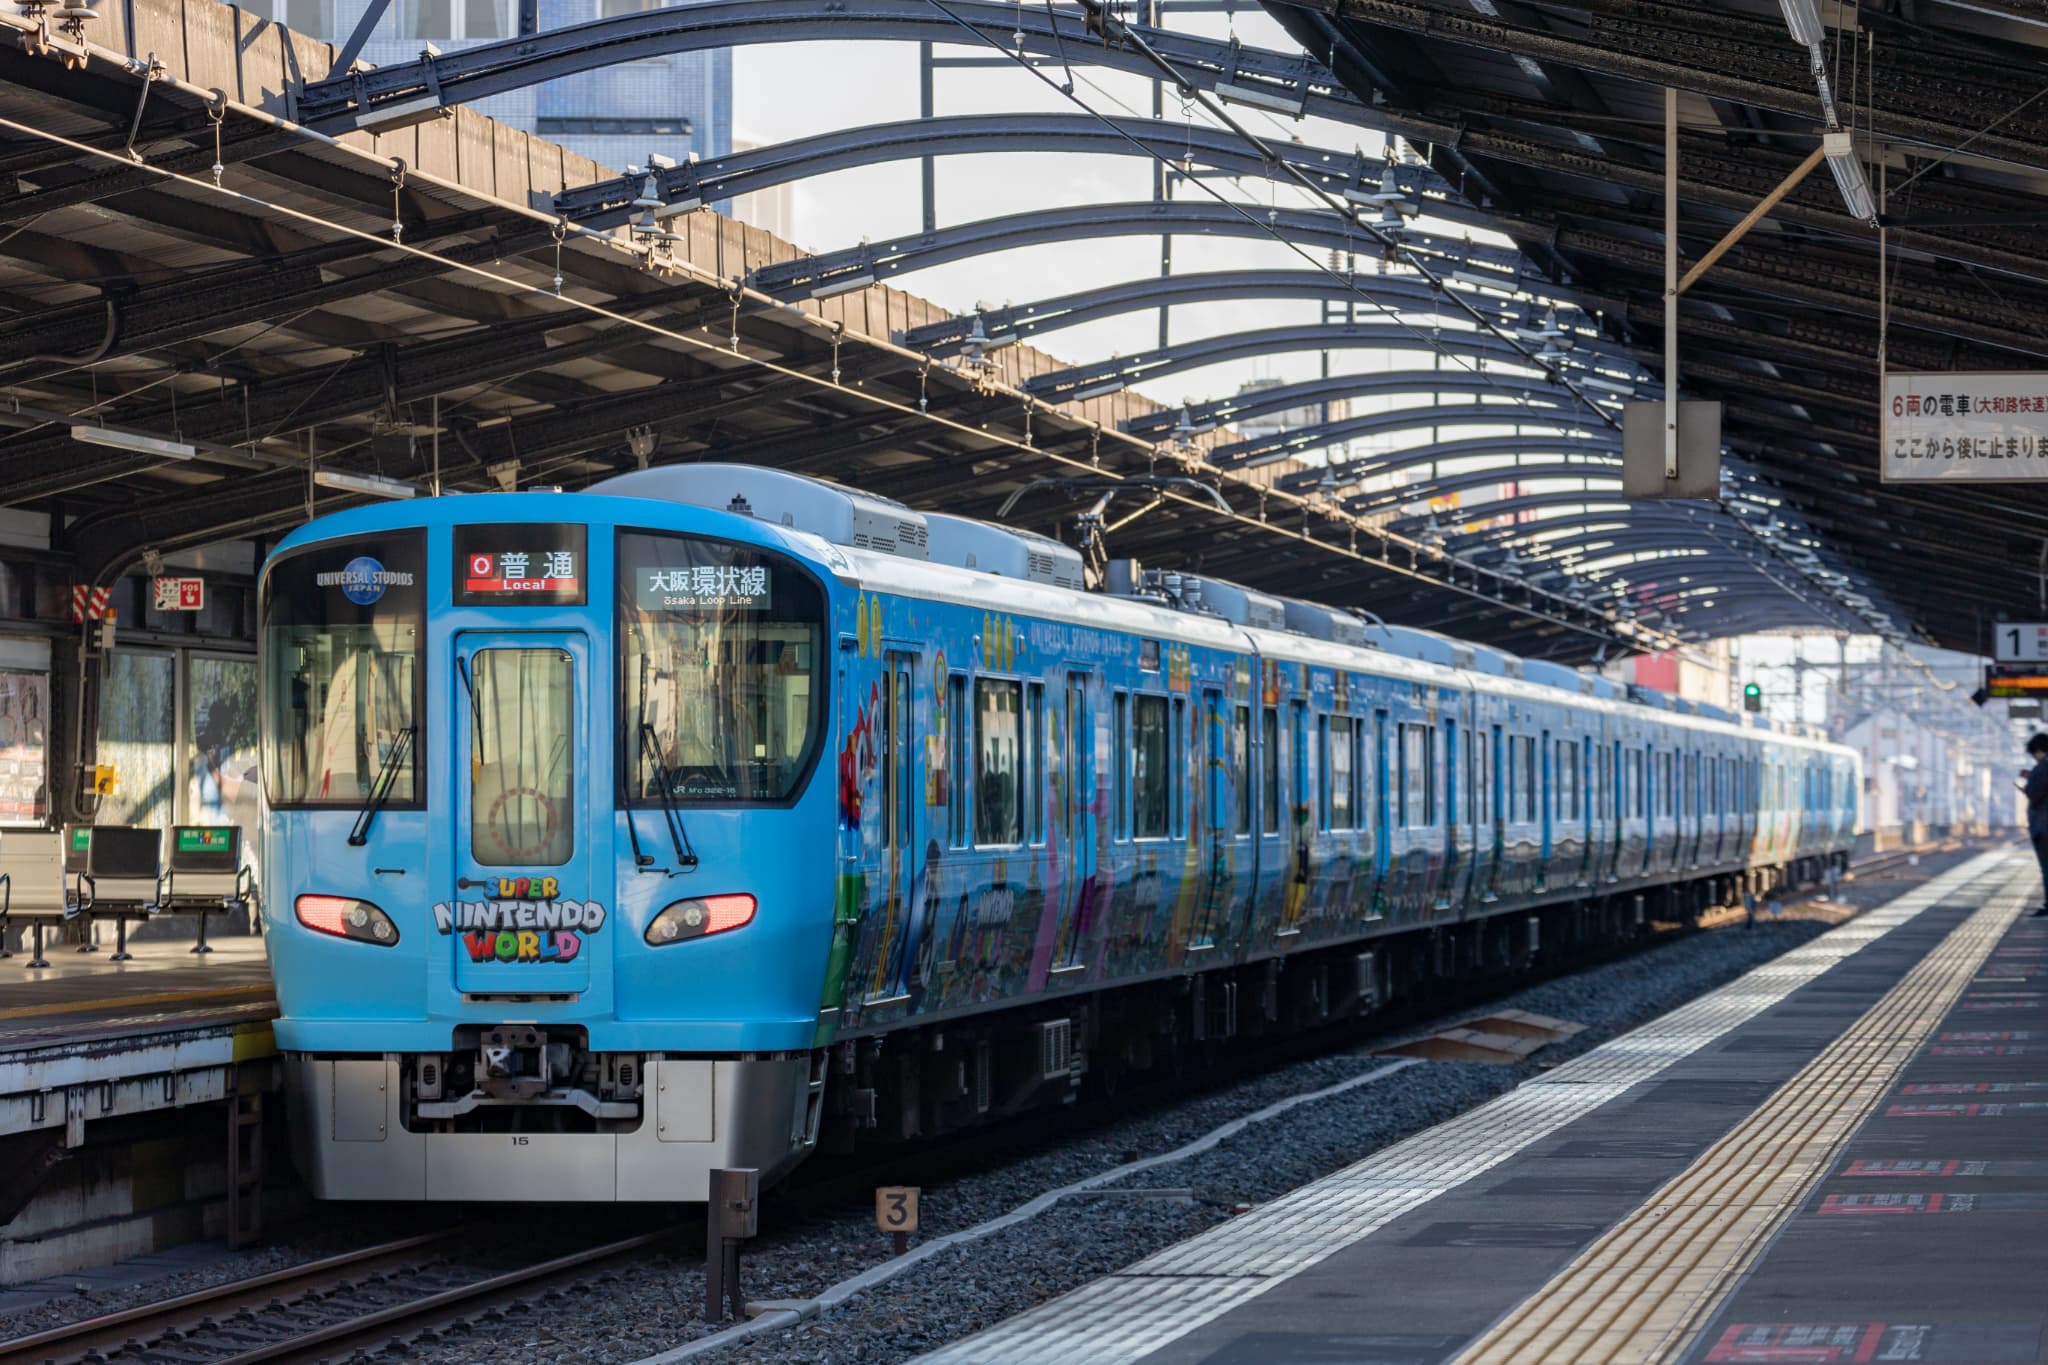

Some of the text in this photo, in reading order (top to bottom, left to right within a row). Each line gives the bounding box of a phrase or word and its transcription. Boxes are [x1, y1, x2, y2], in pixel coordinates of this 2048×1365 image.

[1895, 436, 2048, 459] ここから後に止まりま
[500, 551, 574, 579] 普通
[316, 571, 414, 587] UNIVERSAL STUDIOS
[348, 584, 381, 593] JAPAN
[503, 579, 545, 590] Local
[649, 566, 767, 596] 大阪環状線
[699, 596, 726, 606] Loop
[730, 596, 753, 606] Line
[2007, 628, 2020, 657] 1
[484, 876, 560, 900] SUPER
[432, 899, 607, 935] NINTENDO
[463, 930, 582, 963] WORLD
[512, 1136, 529, 1146] 15
[886, 1193, 908, 1226] 3
